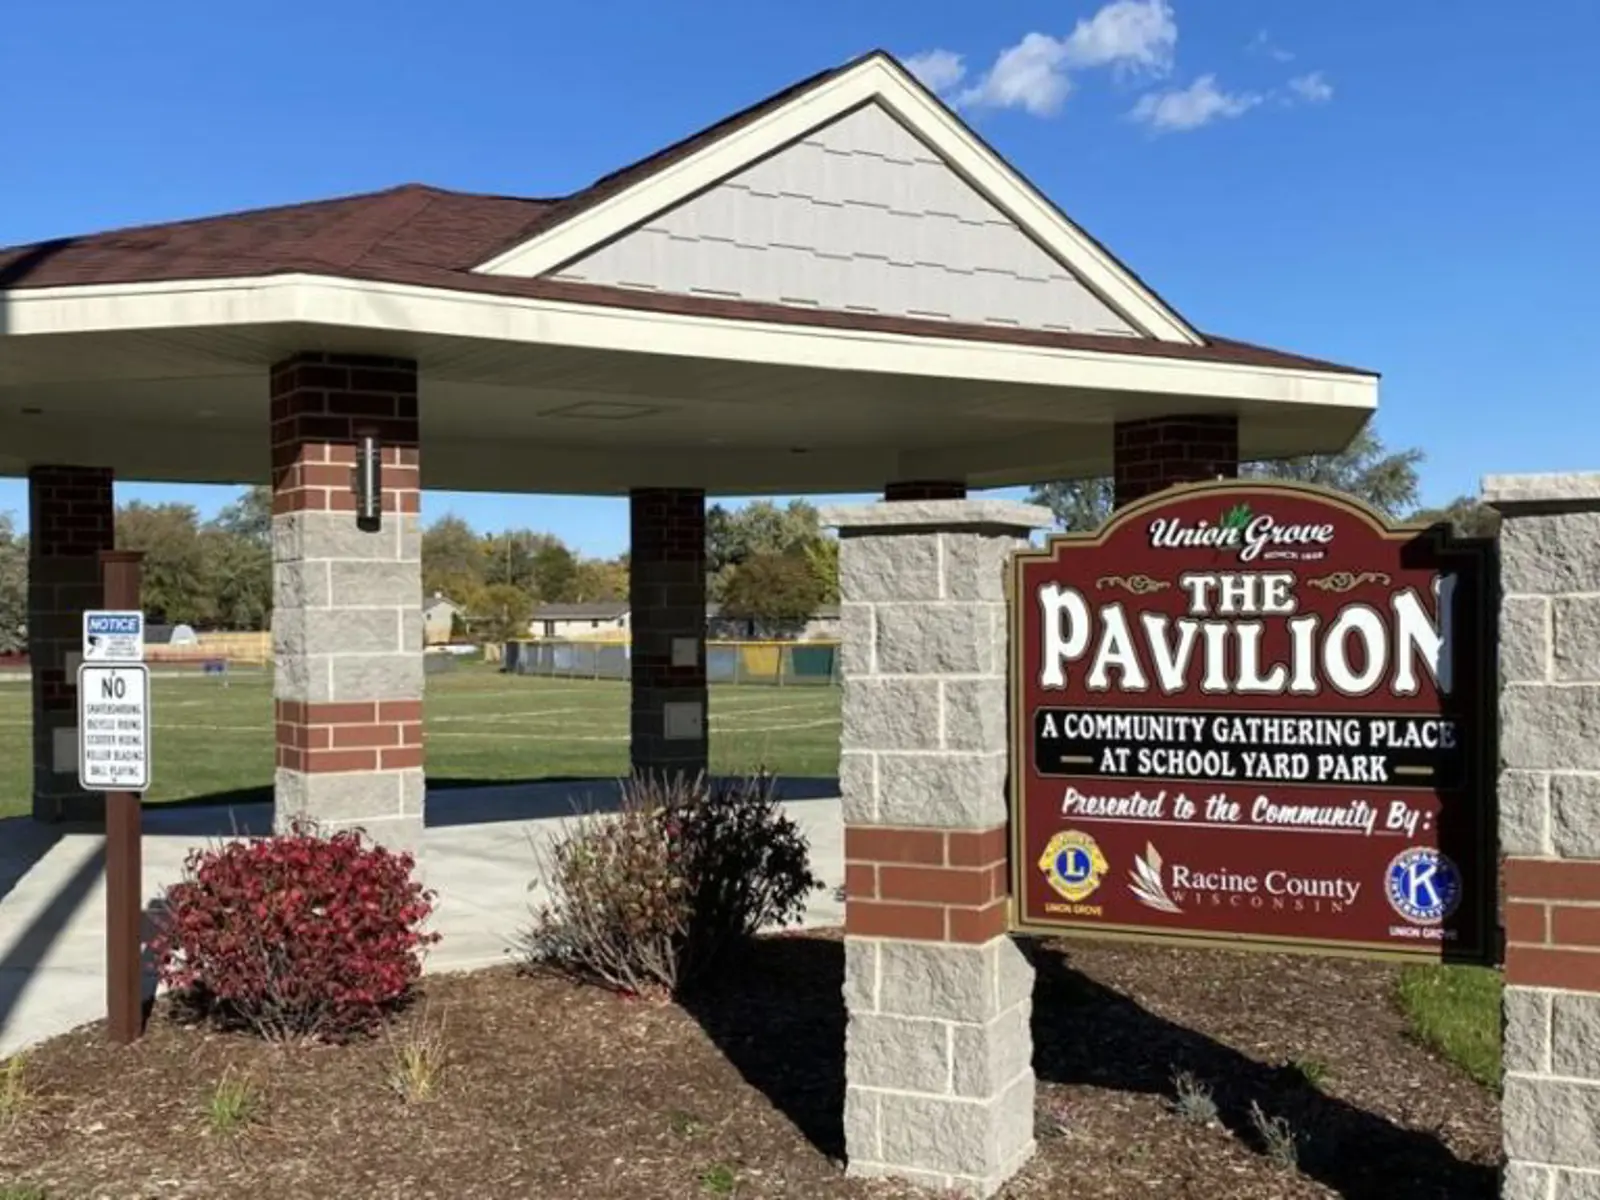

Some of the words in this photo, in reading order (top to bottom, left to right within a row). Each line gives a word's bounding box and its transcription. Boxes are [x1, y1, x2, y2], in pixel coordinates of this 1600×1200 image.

[1150, 517, 1242, 548] Union
[1240, 514, 1335, 562] Grove
[1181, 573, 1298, 613] THE
[90, 618, 138, 631] NOTICE
[1039, 573, 1458, 695] PAVILION
[101, 676, 126, 700] NO
[1041, 713, 1059, 739] A
[1064, 713, 1206, 743] COMMUNITY
[1211, 716, 1362, 747] GATHERING
[1369, 719, 1457, 749] PLACE
[1100, 746, 1131, 773] AT
[1137, 748, 1236, 777] SCHOOL
[1241, 750, 1310, 779] YARD
[1317, 753, 1389, 782] PARK
[1061, 786, 1167, 819] Presented
[1172, 792, 1197, 819] to
[1204, 793, 1243, 822] the
[1251, 795, 1378, 837] Community
[1172, 864, 1259, 894] Racine
[1264, 870, 1361, 905] County
[1172, 891, 1344, 914] WISCONSIN
[1407, 861, 1443, 908] K
[1389, 926, 1421, 938] UNION
